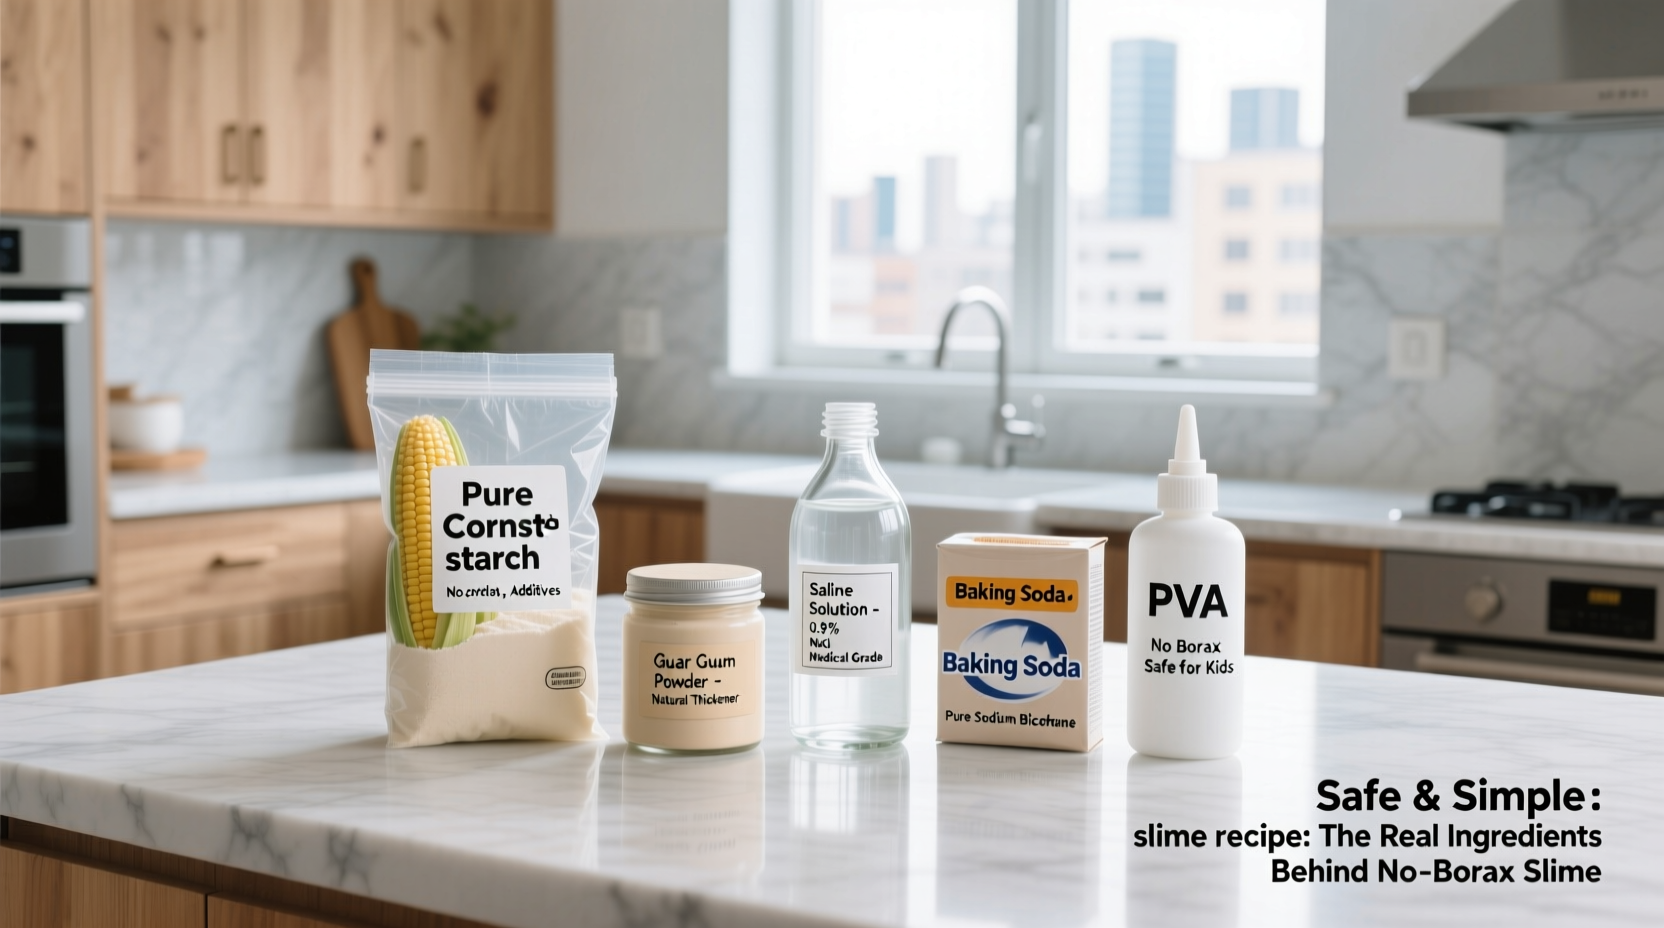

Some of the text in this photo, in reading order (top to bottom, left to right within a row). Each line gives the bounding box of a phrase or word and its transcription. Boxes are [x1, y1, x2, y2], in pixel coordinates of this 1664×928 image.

[462, 481, 534, 507] Pure
[445, 544, 540, 572] starch
[446, 585, 464, 598] No
[809, 582, 854, 597] Saline
[955, 581, 1016, 606] Baking
[809, 601, 868, 616] Solution
[1148, 582, 1229, 619] PVA
[809, 621, 840, 635] 0.9%
[1151, 637, 1221, 654] No Borax
[653, 652, 692, 670] Guar
[943, 651, 1081, 681] Baking Soda
[1144, 658, 1234, 675] Safe for Kids
[654, 672, 709, 689] Powder
[651, 693, 688, 706] Natural
[945, 709, 972, 723] Pure
[974, 711, 1017, 725] Sodium
